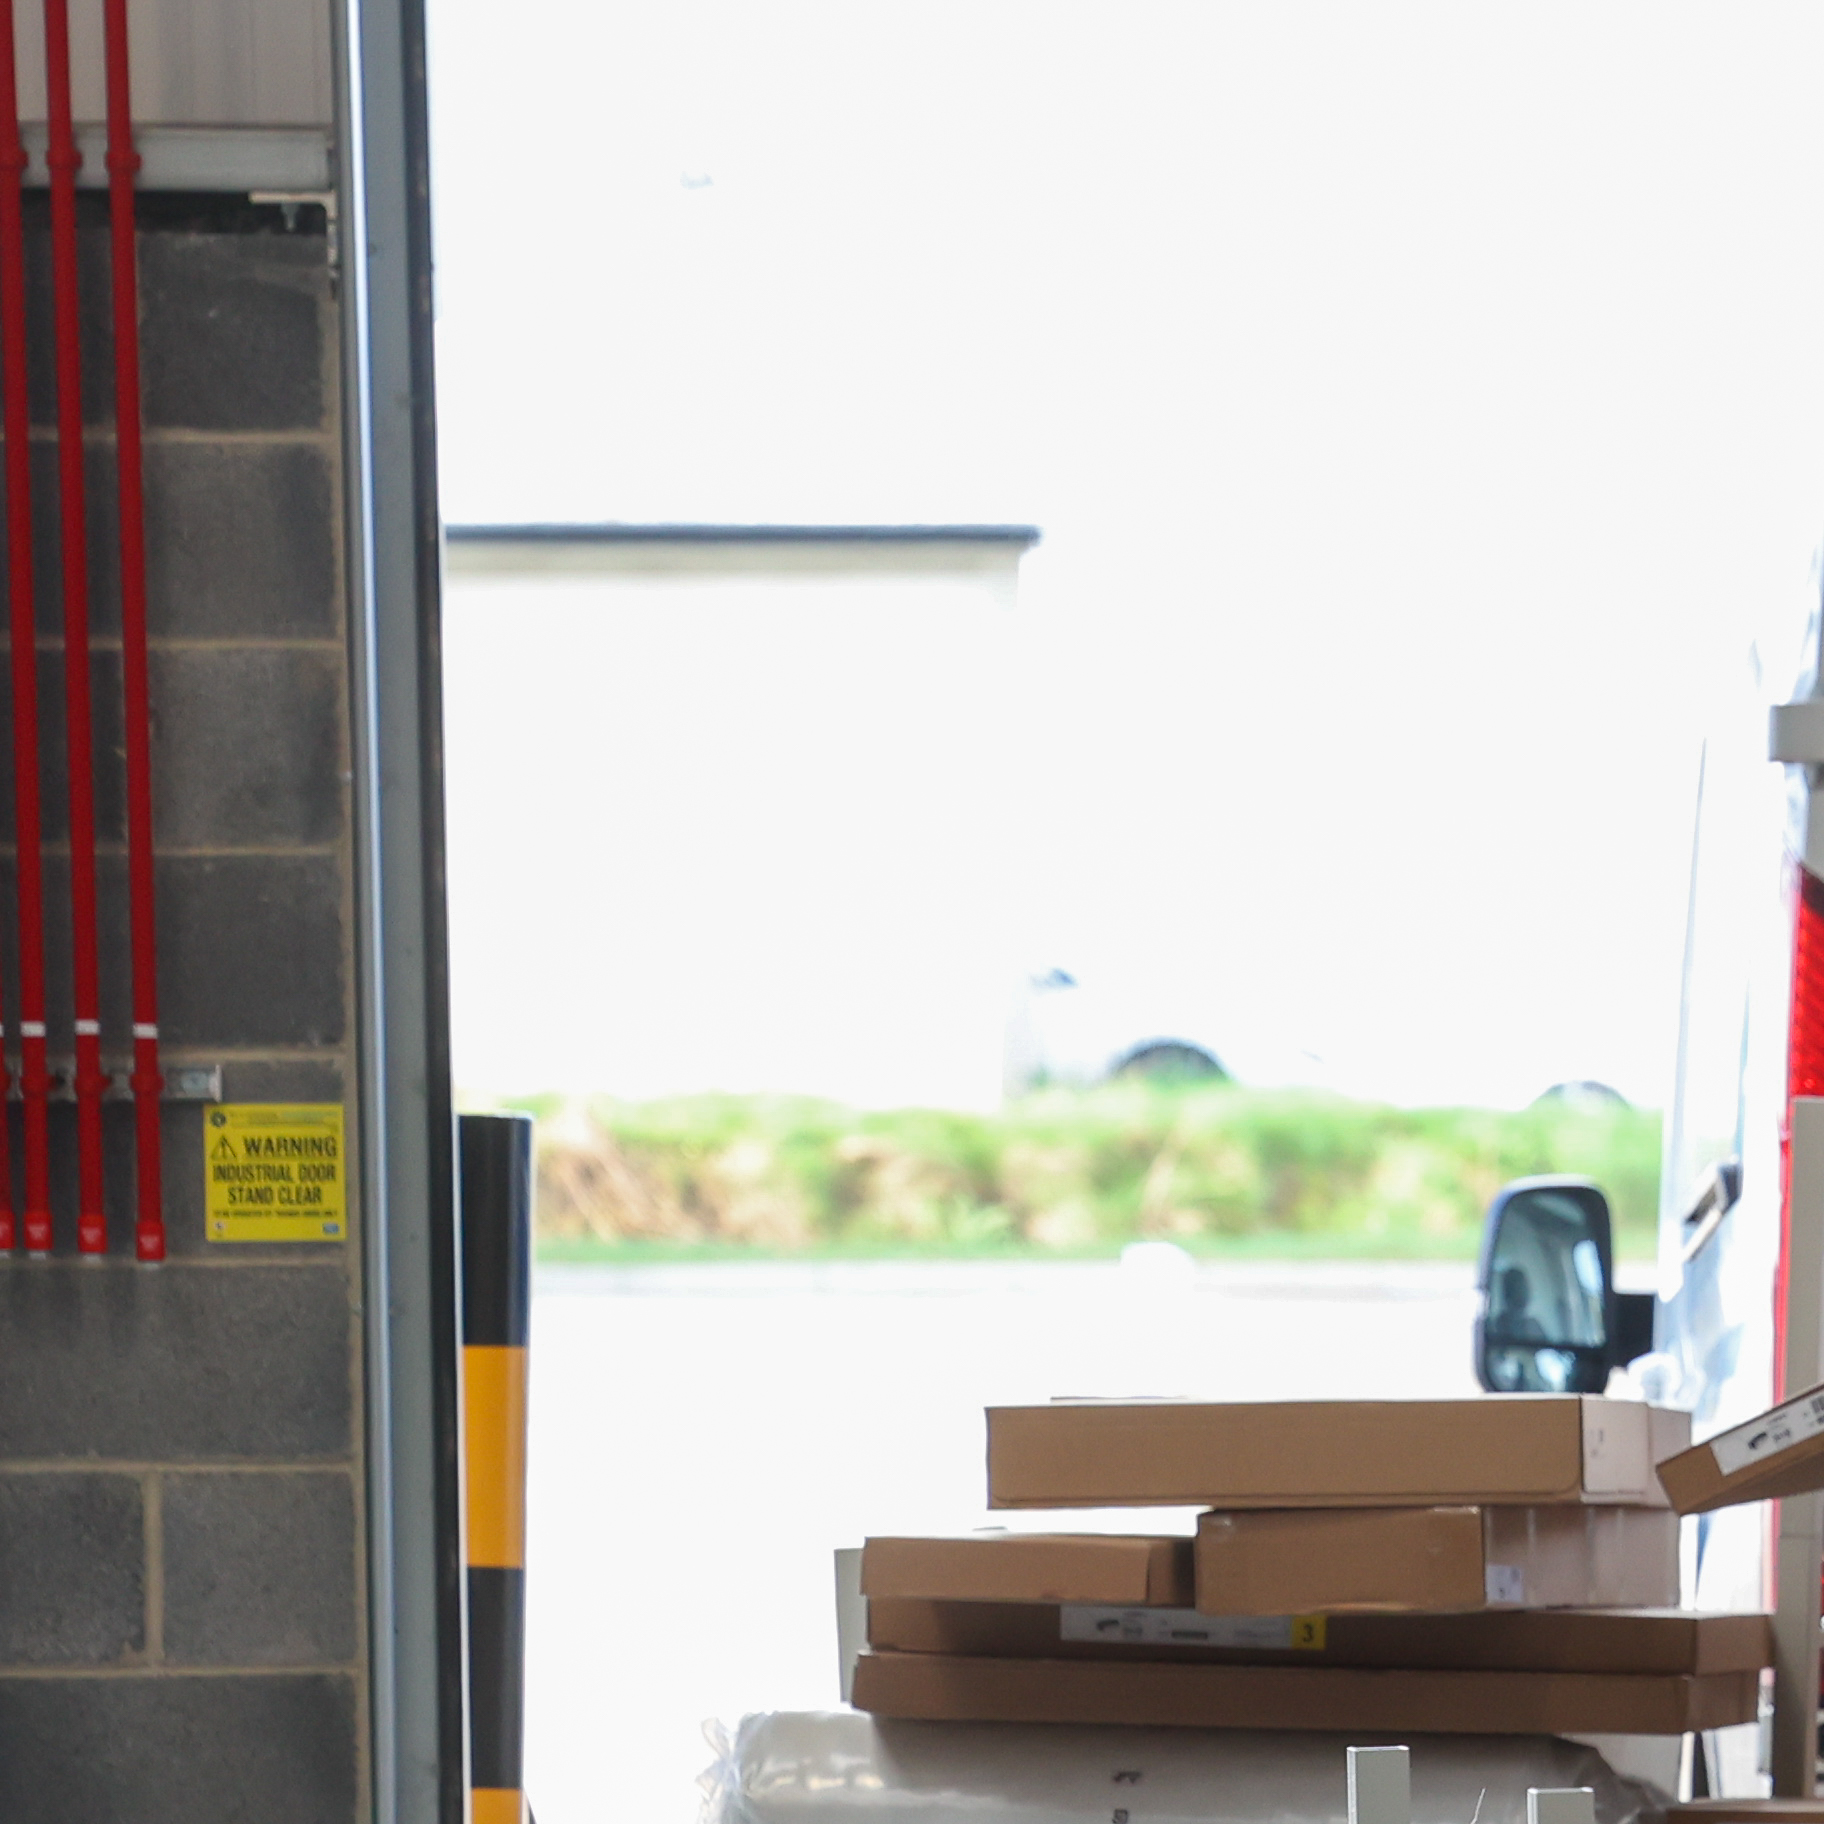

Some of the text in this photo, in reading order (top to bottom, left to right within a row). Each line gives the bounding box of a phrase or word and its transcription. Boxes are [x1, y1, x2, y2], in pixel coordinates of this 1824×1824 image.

[243, 1135, 337, 1157] WARNING
[213, 1163, 336, 1182] INDUSTRIAL DOOR
[228, 1185, 322, 1205] STAND CLEAR
[1302, 1623, 1315, 1644] 3
